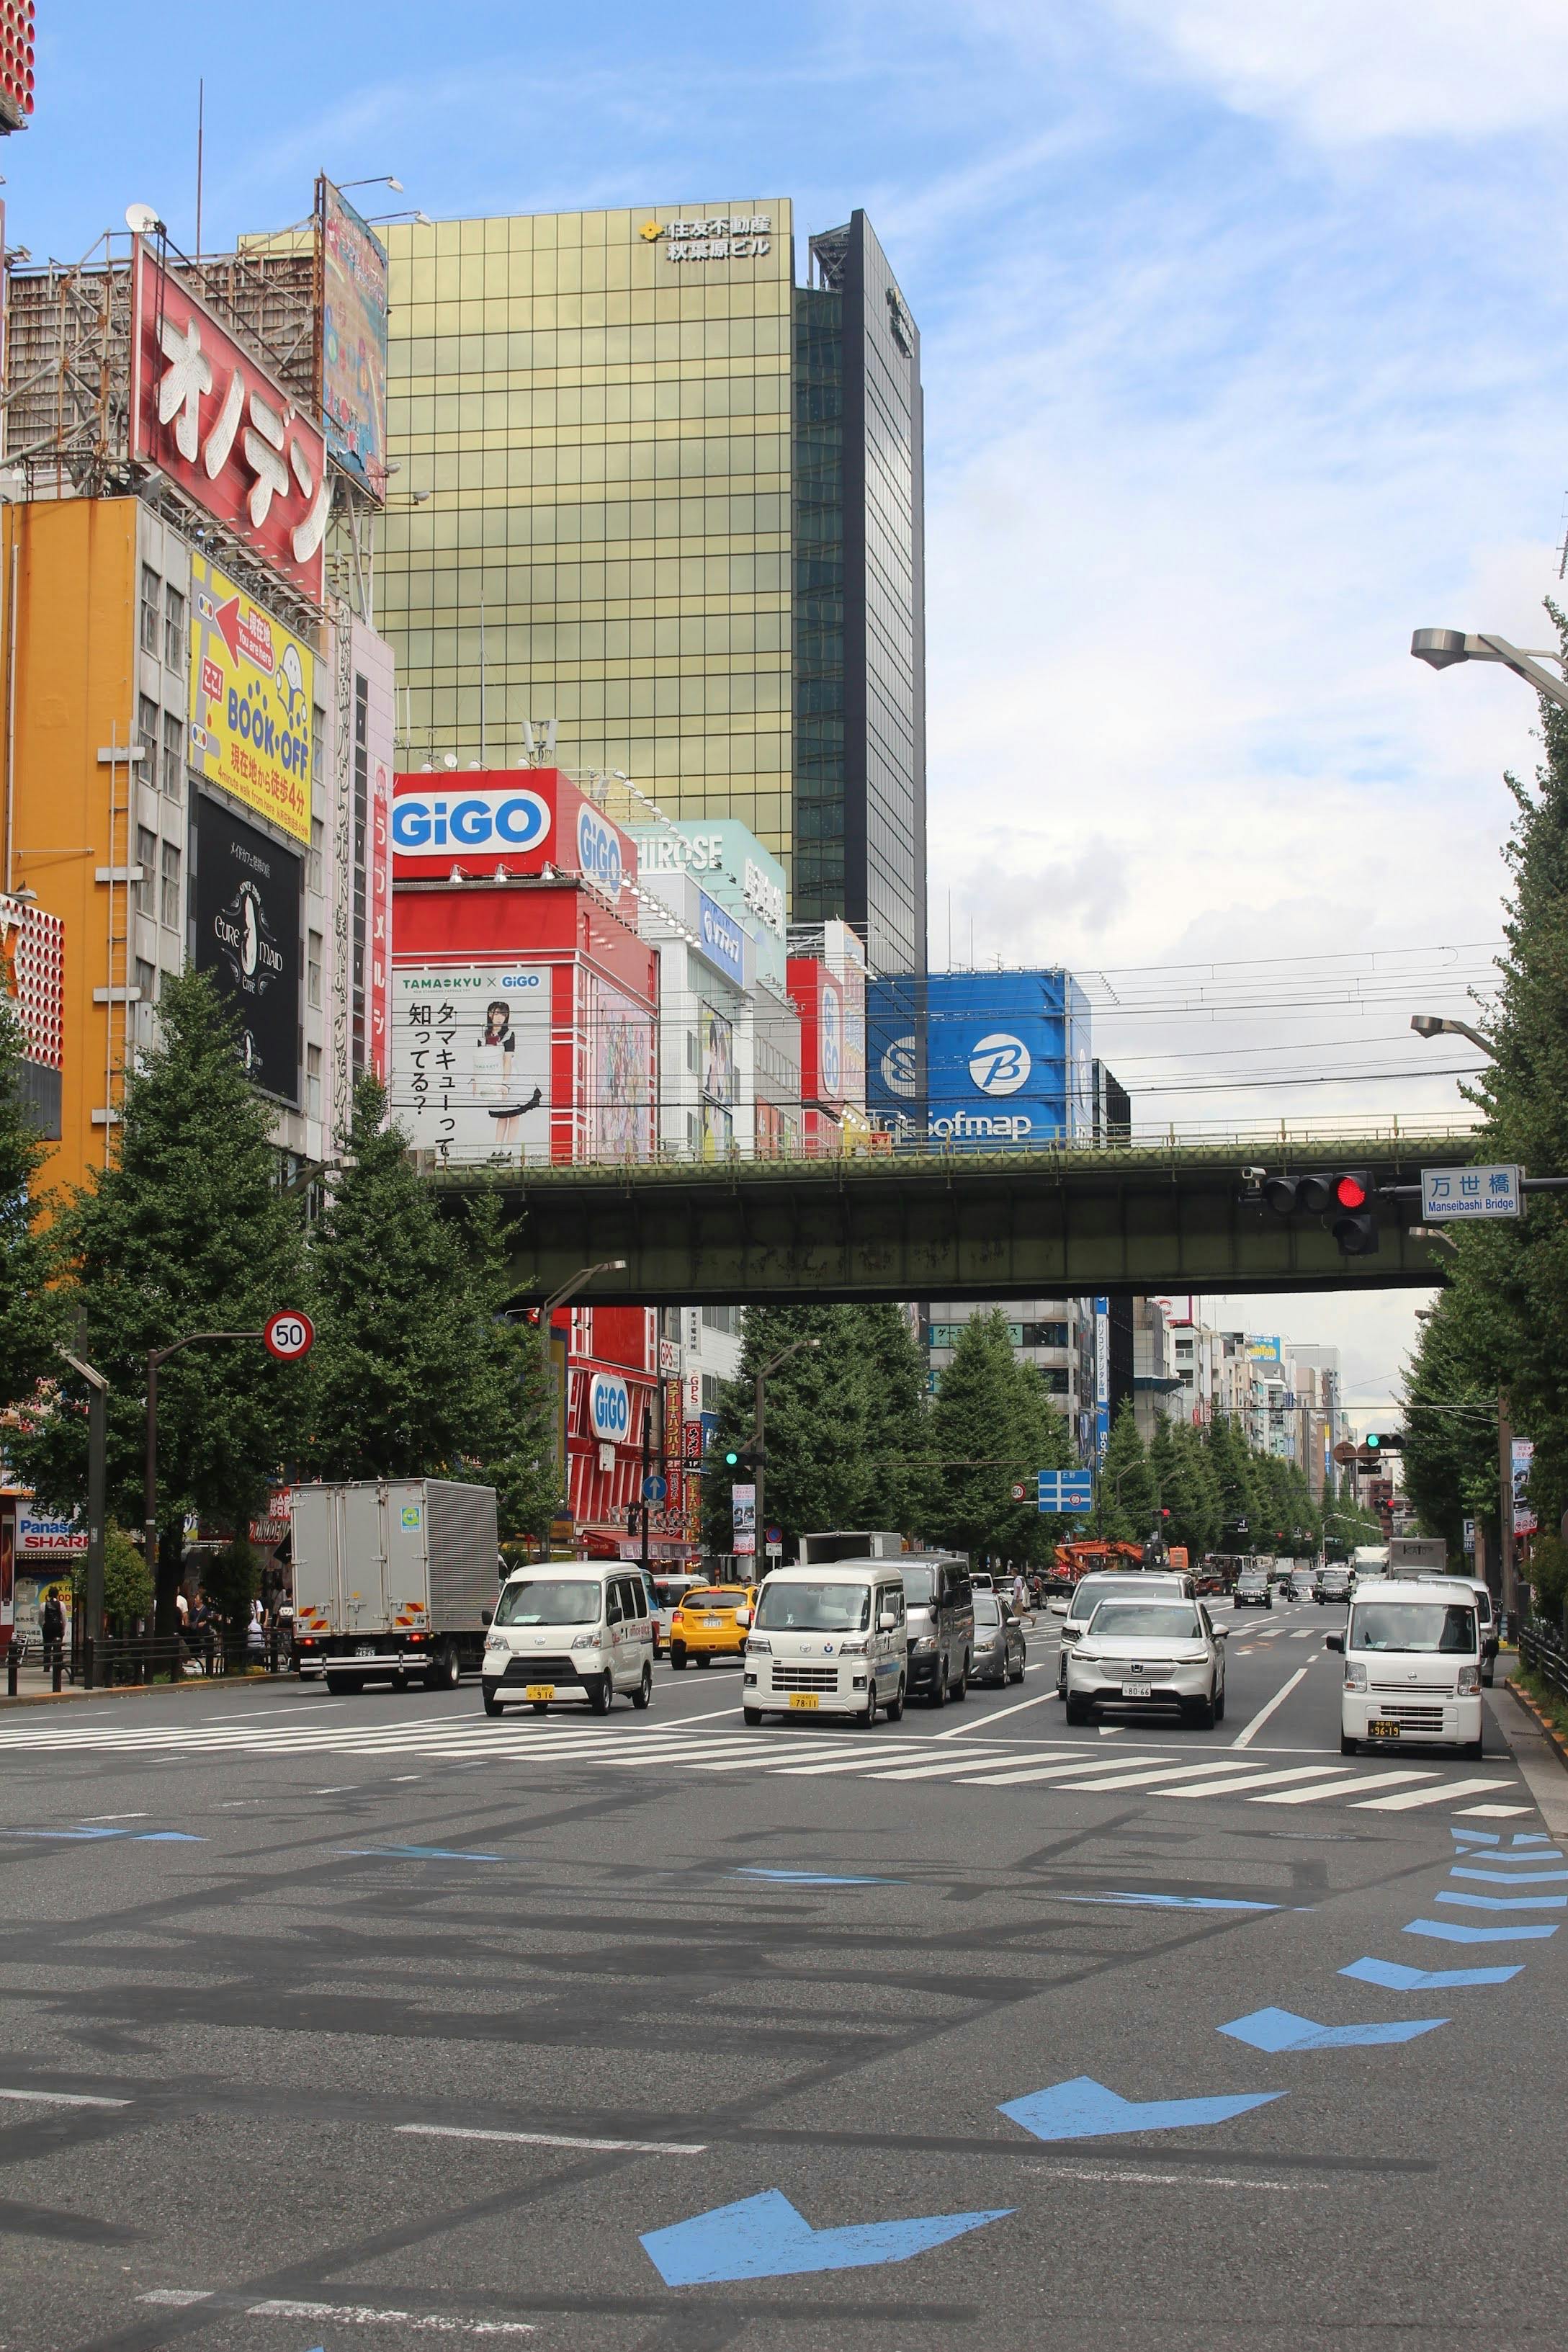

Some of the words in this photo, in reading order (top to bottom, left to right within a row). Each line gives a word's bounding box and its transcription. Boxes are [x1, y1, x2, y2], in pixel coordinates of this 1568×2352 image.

[667, 214, 771, 240] 住友不動産
[667, 238, 769, 261] 秋葉原ビル
[157, 313, 331, 563] オノデン
[249, 611, 271, 646] 現在地
[238, 626, 248, 646] You
[249, 640, 259, 656] are
[259, 645, 272, 666] here
[230, 742, 305, 817] 現在地から徒歩4分
[240, 779, 251, 799] walk
[251, 790, 263, 807] from
[264, 799, 274, 814] here
[393, 797, 542, 849] GiGO
[580, 813, 620, 894] GiGO
[502, 975, 539, 988] GiGO
[435, 1003, 457, 1158] タマキューって
[1430, 1173, 1510, 1197] 万世橋
[1428, 1199, 1482, 1212] Manseibashi
[1486, 1197, 1514, 1211] Bridge
[276, 1324, 303, 1346] 50
[660, 1342, 673, 1368] GPS
[595, 1385, 627, 1431] GiGO
[1466, 1522, 1475, 1534] P
[1374, 1726, 1399, 1736] 96-19
